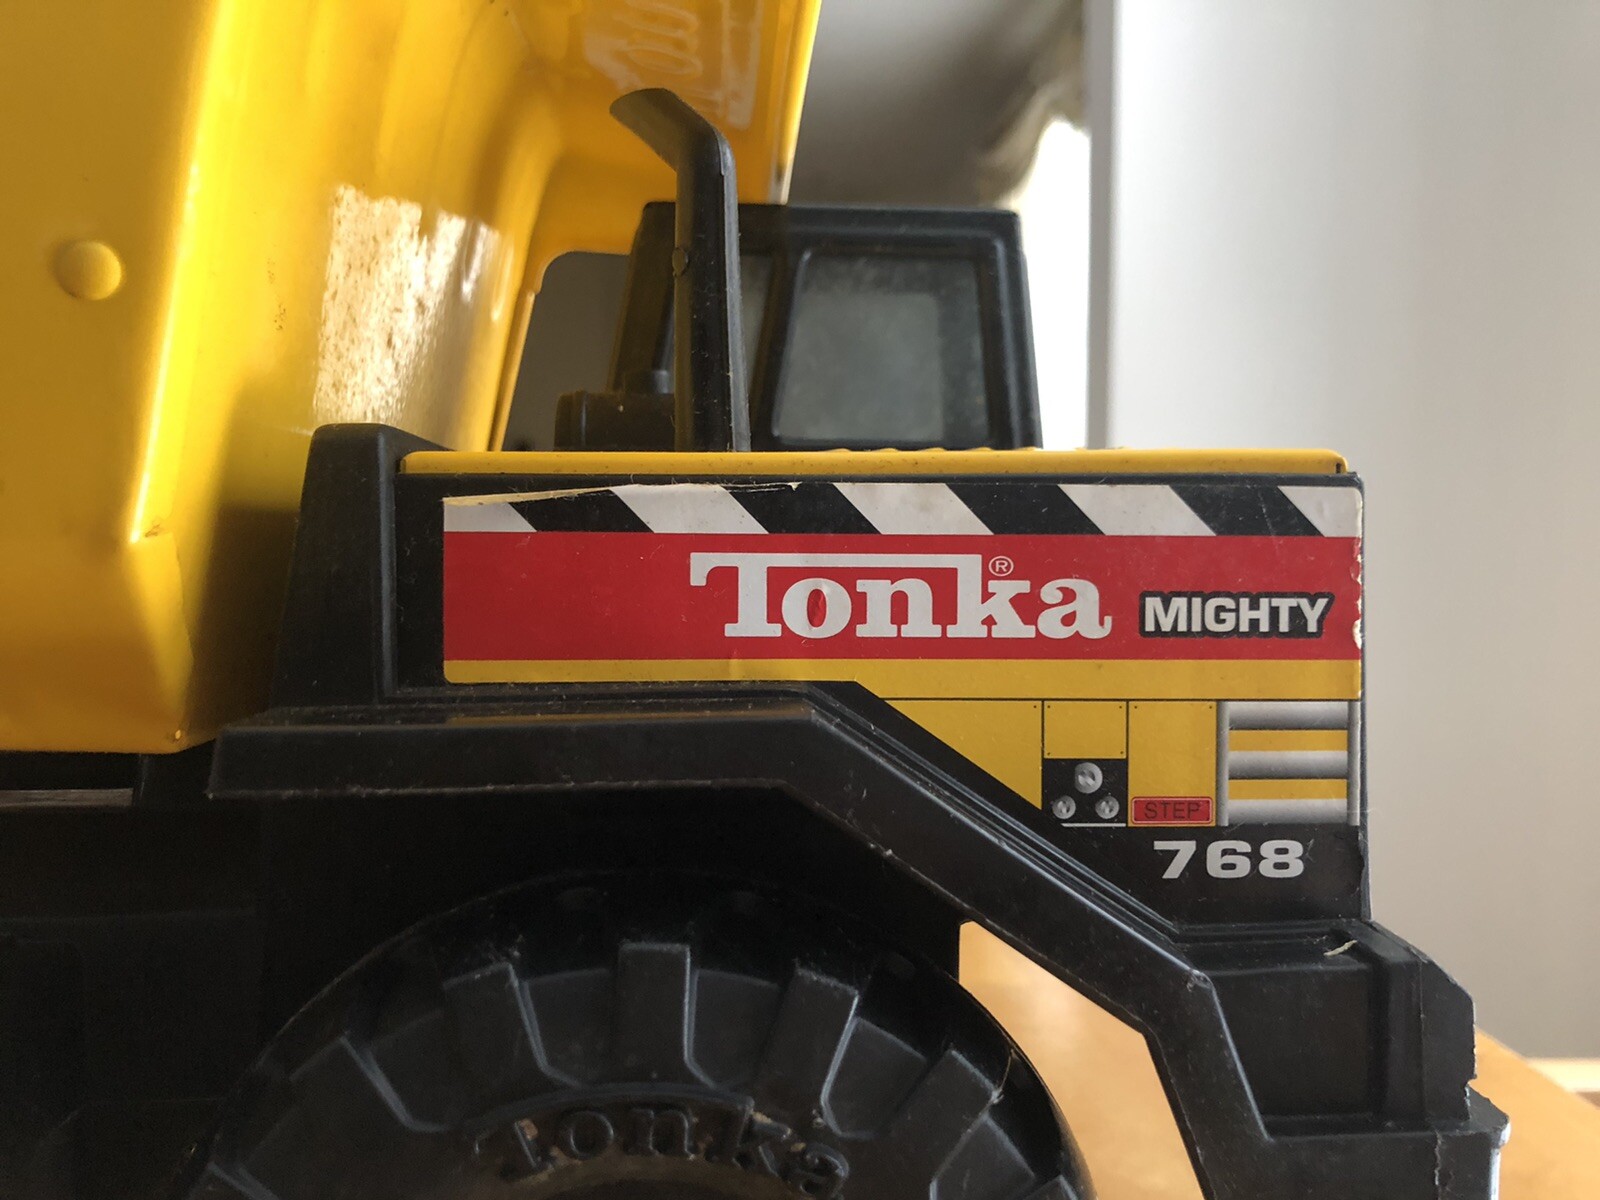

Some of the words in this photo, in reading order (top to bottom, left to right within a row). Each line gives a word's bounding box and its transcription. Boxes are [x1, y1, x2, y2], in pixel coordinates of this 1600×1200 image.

[690, 552, 1112, 640] Tonka
[1143, 596, 1331, 634] MIGHTY
[1144, 801, 1201, 819] STEP
[1153, 840, 1305, 879] 768
